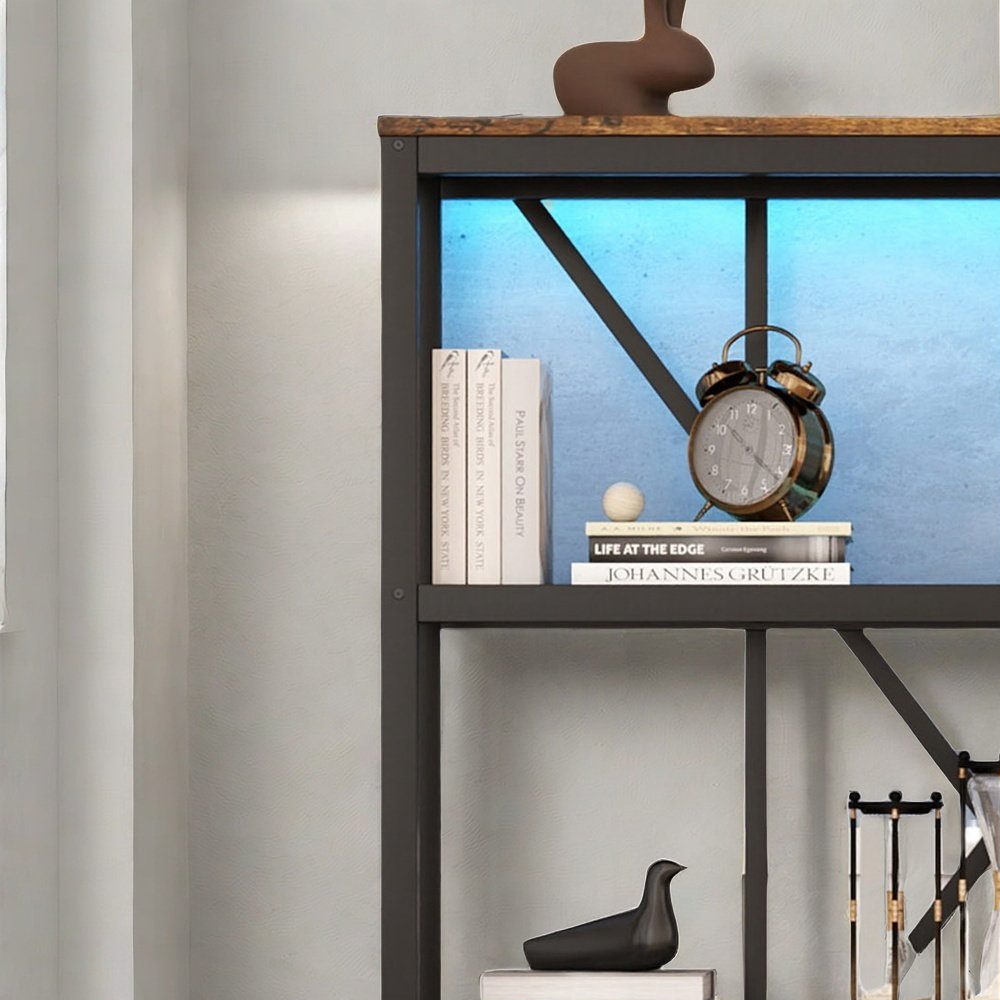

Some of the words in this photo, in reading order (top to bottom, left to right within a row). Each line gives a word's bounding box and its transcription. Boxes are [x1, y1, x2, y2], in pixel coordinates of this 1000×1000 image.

[440, 383, 449, 432] BREEDING
[475, 383, 484, 432] BREEDING
[730, 409, 739, 420] 11
[746, 403, 757, 414] 12
[767, 409, 772, 420] 1
[515, 410, 526, 438] PAUL
[716, 423, 727, 436] 10
[779, 423, 785, 435] 2
[440, 437, 449, 466] BIRDS
[475, 437, 484, 466] BIRDS
[515, 440, 526, 473] STARR
[708, 444, 716, 455] 9
[440, 470, 449, 481] IN
[475, 470, 484, 481] IN
[711, 465, 719, 476] 8
[515, 475, 526, 495] ON
[725, 478, 732, 490] 7
[741, 486, 748, 497] 6
[440, 485, 449, 507] NEW
[475, 485, 484, 507] NEW
[440, 509, 449, 537] YORK
[475, 509, 484, 537] YORK
[515, 498, 526, 537] BEAUTY
[440, 541, 449, 570] STATE
[475, 541, 484, 570] STATE
[594, 543, 621, 555] LIFE
[623, 543, 640, 555] AT
[642, 543, 667, 555] THE
[669, 543, 705, 555] EDGE
[605, 567, 724, 582] JOHANNES
[728, 565, 835, 581] GRÜTZKE
